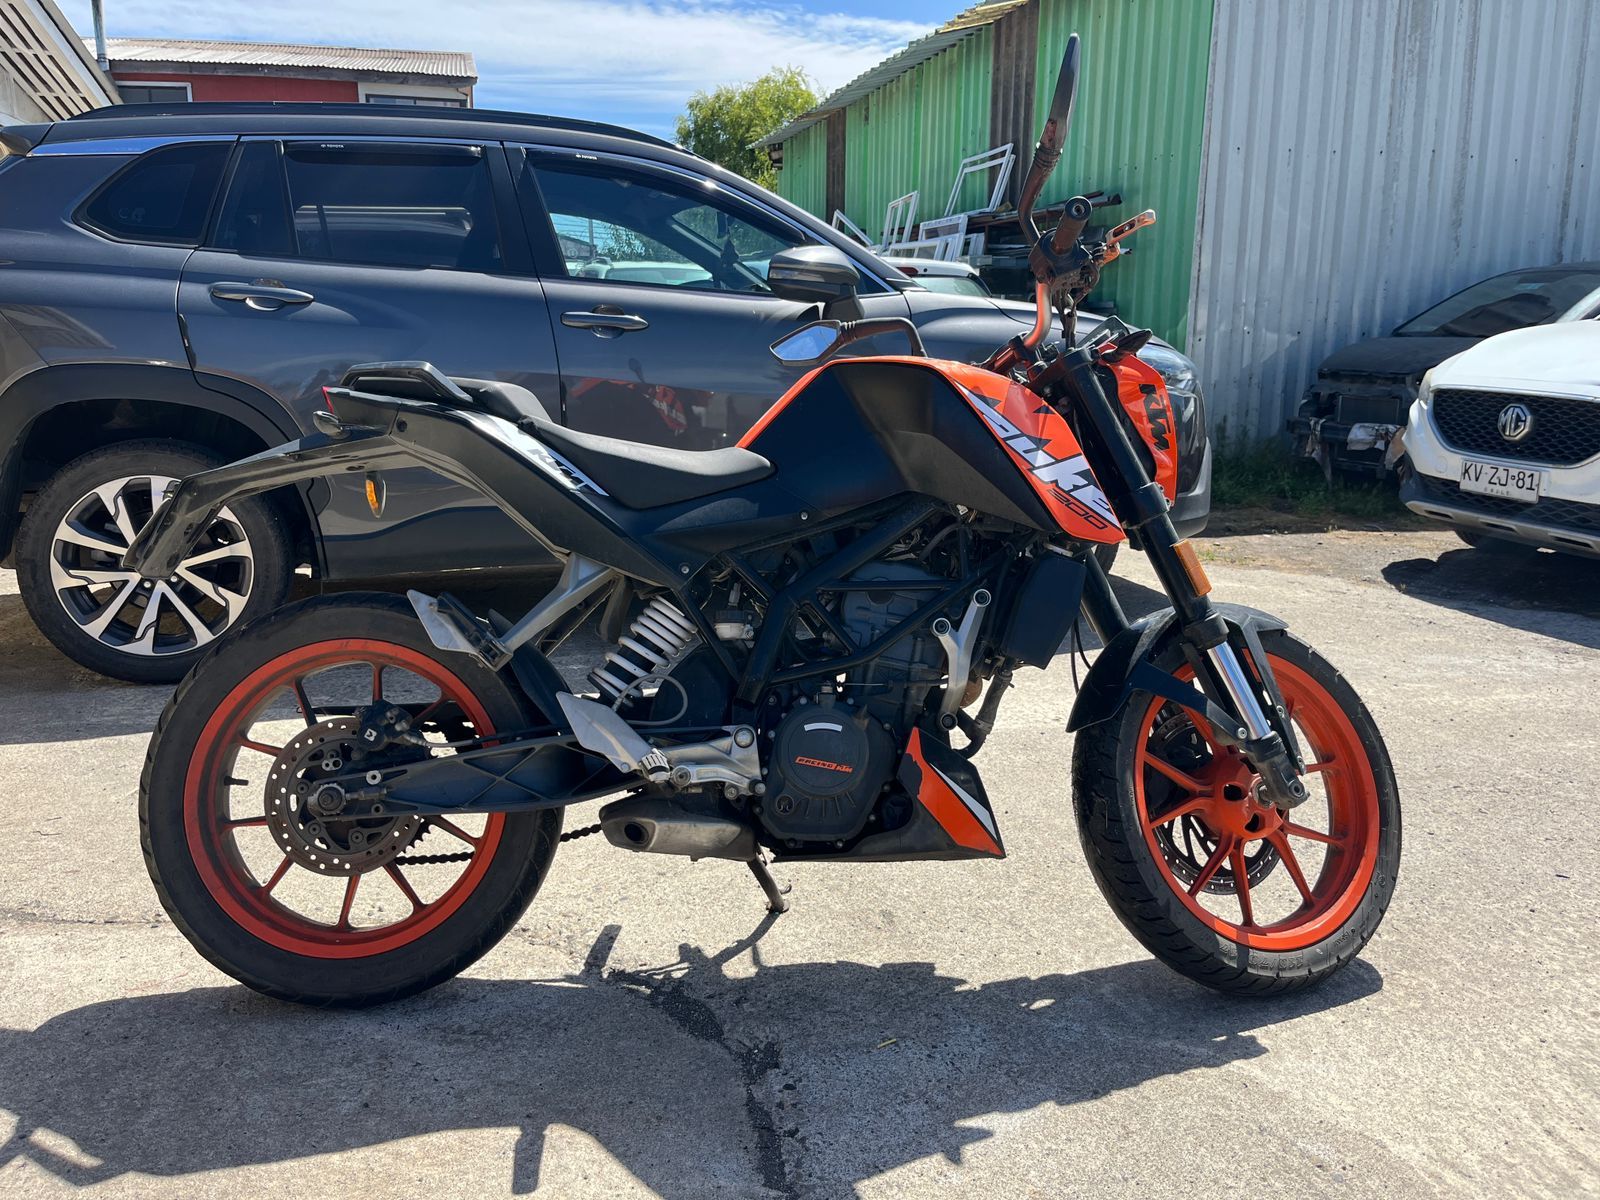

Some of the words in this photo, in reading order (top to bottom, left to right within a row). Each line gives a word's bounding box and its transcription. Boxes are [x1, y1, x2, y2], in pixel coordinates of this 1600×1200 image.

[1138, 383, 1171, 450] KTM
[1500, 404, 1528, 438] MG
[1049, 487, 1108, 530] 200
